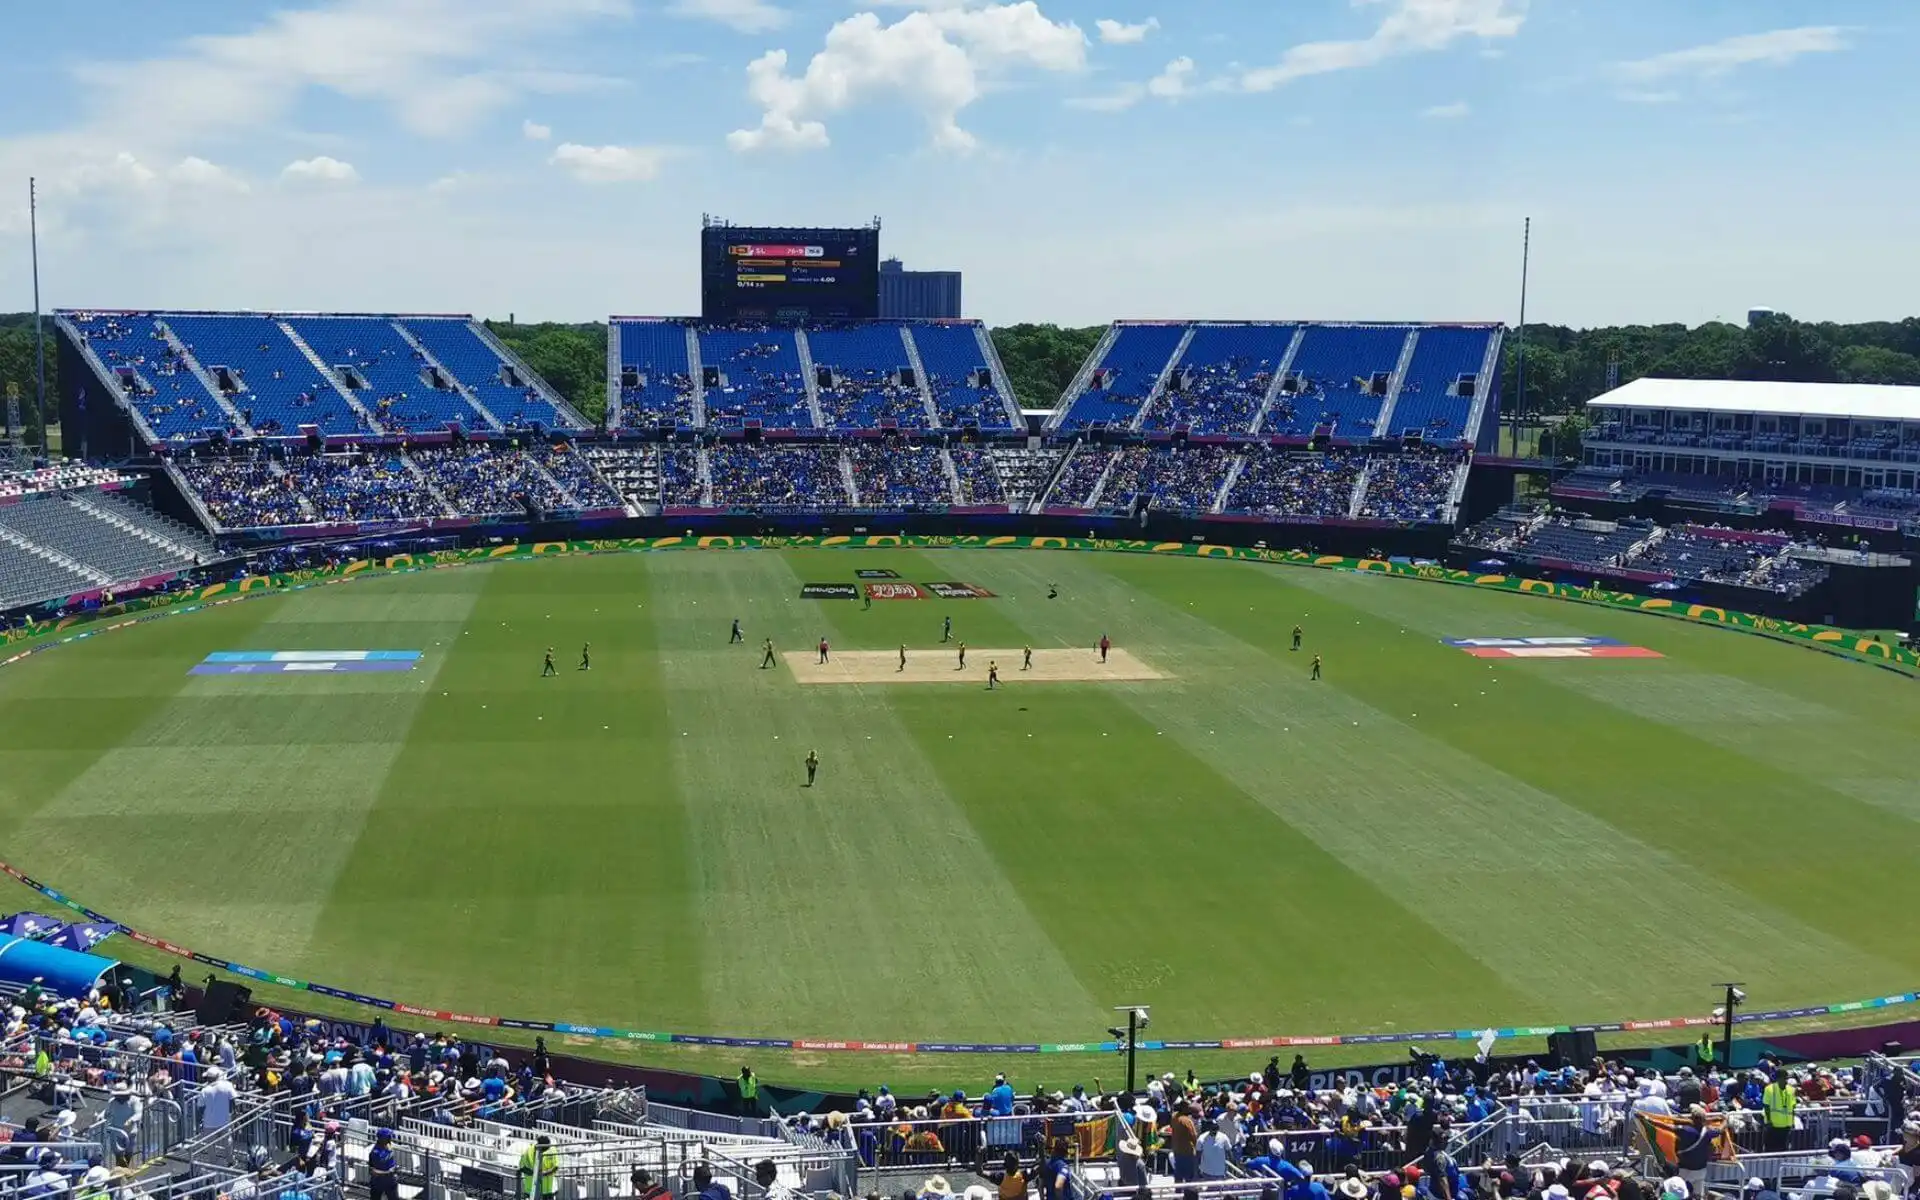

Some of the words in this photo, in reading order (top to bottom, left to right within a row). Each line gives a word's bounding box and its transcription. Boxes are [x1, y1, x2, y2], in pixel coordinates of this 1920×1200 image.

[569, 1024, 598, 1034] aramco
[627, 1031, 656, 1040] aramco
[1056, 1043, 1086, 1051] aramco
[1290, 1140, 1316, 1153] 147
